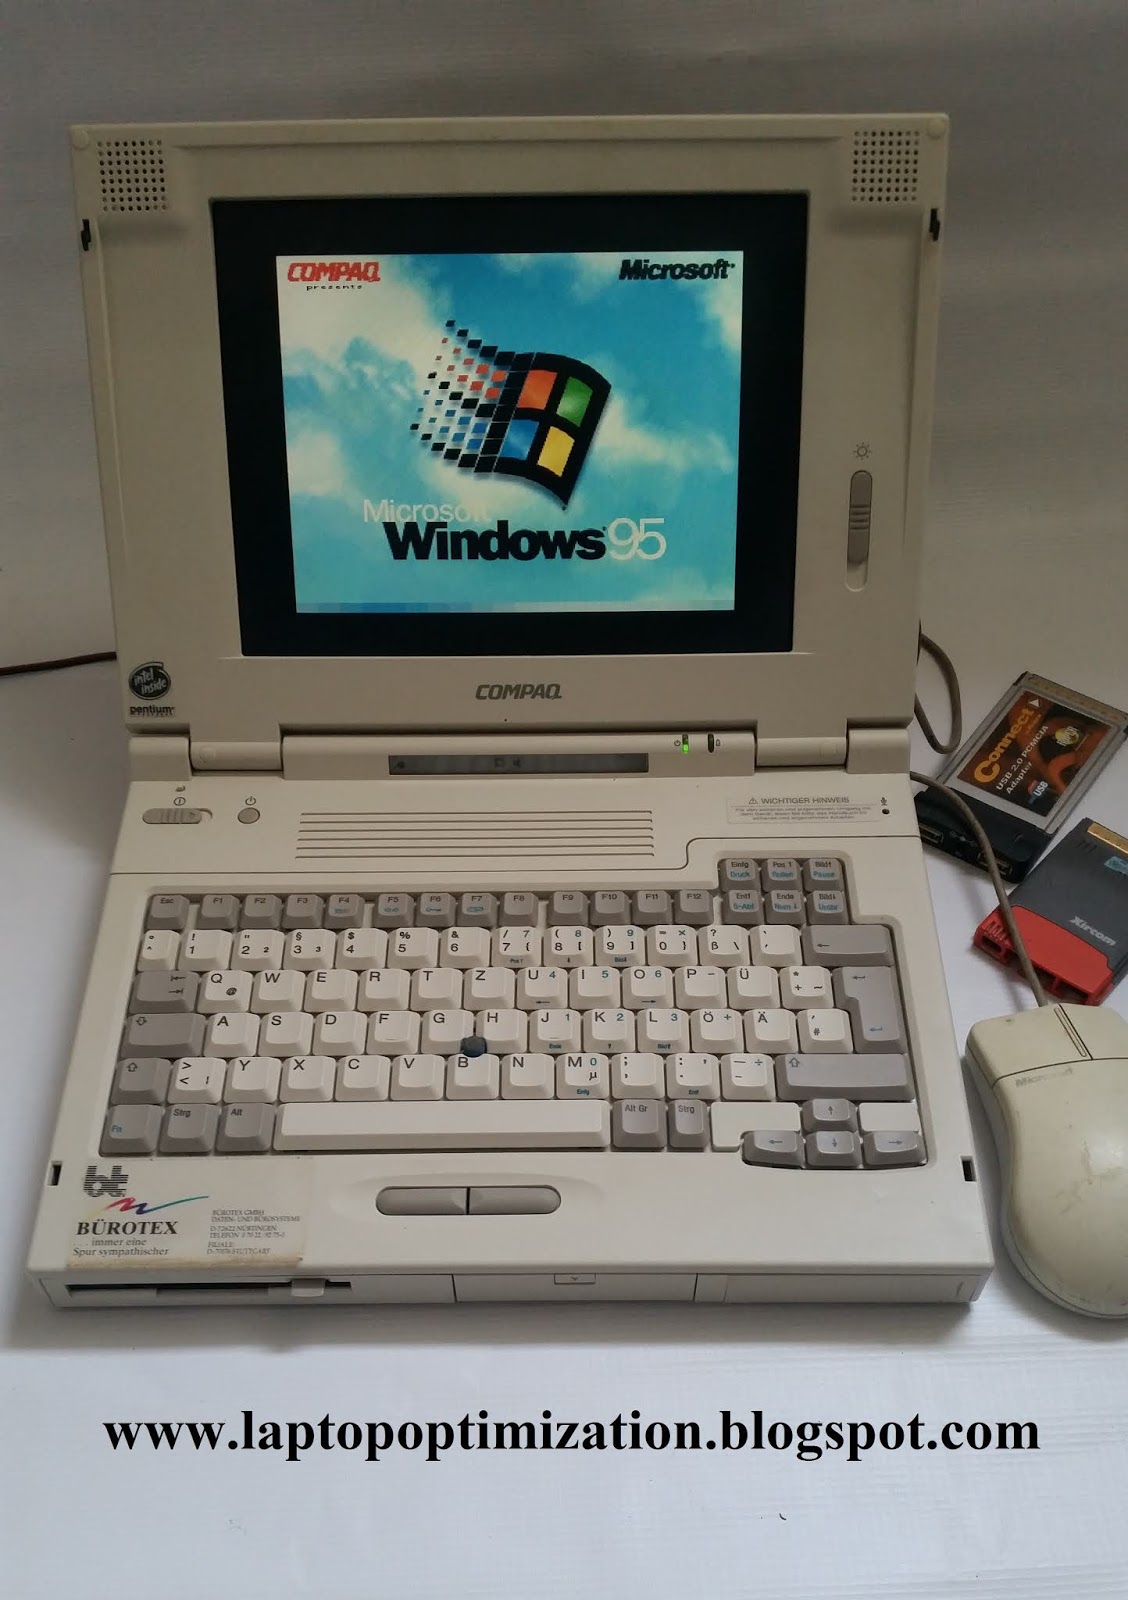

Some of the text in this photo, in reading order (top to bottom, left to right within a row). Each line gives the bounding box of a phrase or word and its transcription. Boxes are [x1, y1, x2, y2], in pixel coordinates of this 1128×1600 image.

[287, 262, 381, 282] COMPAQ
[618, 258, 734, 281] Microsoft
[363, 499, 492, 523] Microsoft
[382, 517, 667, 561] Windows 95
[134, 667, 154, 687] intel
[141, 678, 167, 695] inside
[475, 683, 562, 700] COMPAQ
[130, 704, 173, 715] pentium
[974, 707, 1035, 783] Connect
[995, 770, 1013, 791] USB
[1011, 757, 1024, 772] 2.0
[1021, 725, 1048, 759] PCMCIA
[1006, 761, 1032, 795] Adapter
[1033, 780, 1049, 797] USB
[812, 796, 850, 804] HINWEIS
[347, 931, 355, 940] $
[399, 931, 411, 940] %
[451, 930, 459, 939] &
[522, 930, 530, 938] 7
[574, 929, 582, 938] 8
[626, 929, 634, 937] 9
[710, 928, 717, 937] ?
[1069, 915, 1117, 946] Xircom
[188, 946, 195, 954] 1
[241, 945, 250, 954] 2
[293, 945, 302, 954] 3
[346, 944, 355, 953] 4
[398, 944, 406, 953] 5
[450, 943, 459, 952] 6
[502, 942, 511, 951] 7
[555, 942, 563, 951] 8
[606, 942, 615, 951] 9
[211, 973, 223, 984] Q
[264, 972, 281, 983] W
[316, 972, 327, 982] E
[369, 971, 381, 982] R
[423, 970, 433, 981] T
[475, 970, 486, 981] Z
[528, 969, 539, 980] U
[549, 970, 556, 979] 4
[601, 970, 609, 978] 5
[654, 970, 662, 978] 6
[687, 969, 697, 979] P
[739, 968, 749, 980] Ü
[225, 987, 237, 996] @
[217, 1015, 229, 1027] A
[271, 1015, 282, 1026] S
[324, 1014, 337, 1025] D
[379, 1013, 390, 1024] F
[433, 1013, 445, 1024] G
[486, 1012, 499, 1023] H
[541, 1012, 549, 1023] J
[595, 1012, 606, 1023] K
[616, 1013, 624, 1021] 2
[649, 1012, 658, 1023] L
[670, 1013, 678, 1021] 3
[703, 1011, 714, 1023] Ö
[757, 1011, 768, 1023] Ä
[813, 1027, 820, 1036] #
[239, 1060, 251, 1071] Y
[293, 1059, 305, 1070] X
[348, 1058, 360, 1070] C
[404, 1058, 415, 1069] V
[457, 1057, 469, 1068] B
[513, 1056, 525, 1068] N
[568, 1056, 582, 1067] M
[173, 1108, 191, 1118] Strg
[230, 1108, 243, 1116] Alt
[624, 1104, 648, 1112] Alt Gr
[678, 1104, 695, 1114] Strg
[111, 1125, 122, 1133] Fn
[76, 1218, 178, 1235] BÜROTEX
[91, 1237, 147, 1246] immer eine
[73, 1247, 169, 1257] Spur sympathischer
